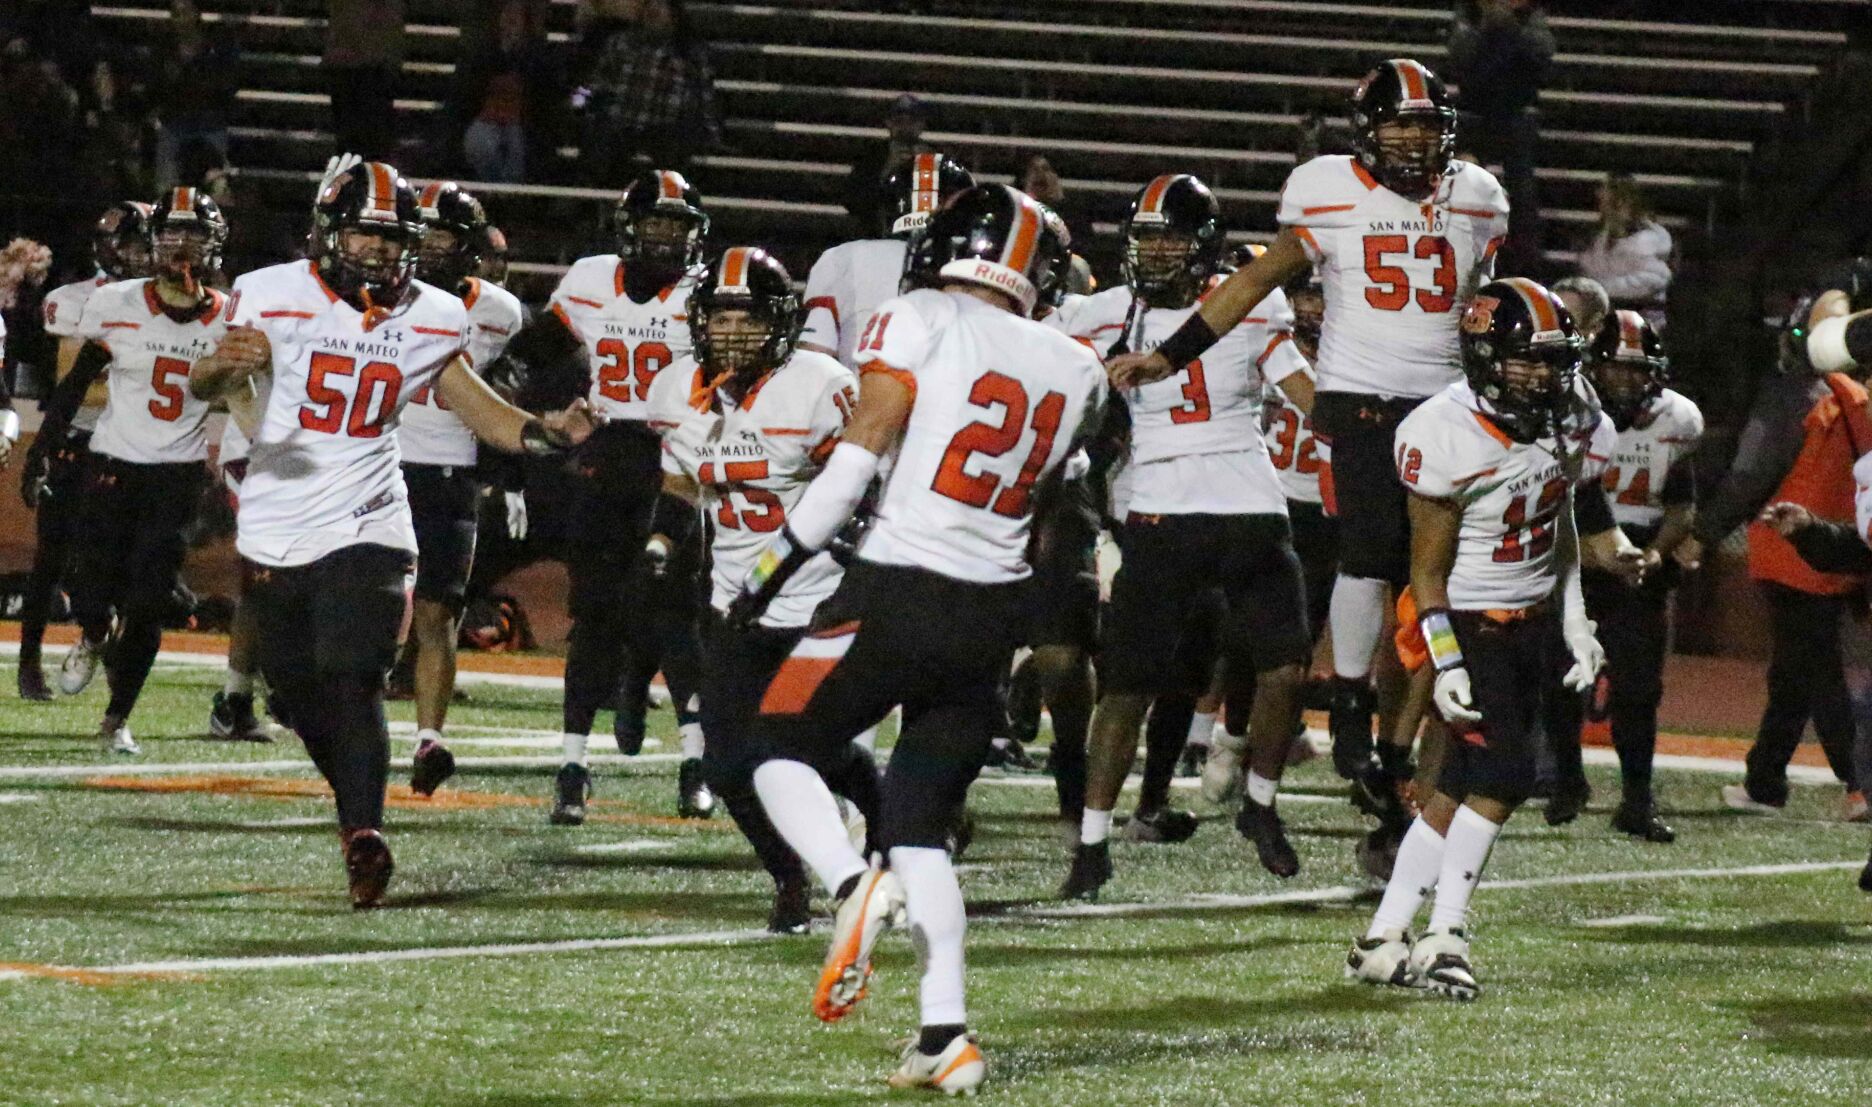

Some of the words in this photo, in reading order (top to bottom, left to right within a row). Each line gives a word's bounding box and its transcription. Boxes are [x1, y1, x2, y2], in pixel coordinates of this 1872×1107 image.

[1369, 221, 1394, 231] SAN
[1402, 220, 1443, 232] MATO
[1362, 235, 1457, 313] 53
[146, 341, 165, 351] SAN
[322, 337, 348, 349] SAN
[355, 342, 399, 358] MATEO
[604, 323, 623, 335] SAN
[628, 327, 666, 339] MATEO
[858, 312, 894, 350] 21
[148, 356, 190, 422] 5
[298, 351, 403, 438] 50
[695, 446, 715, 457] SAN
[721, 444, 763, 456] MATEO
[930, 370, 1066, 519] 21
[1397, 441, 1422, 484] 12
[698, 459, 785, 533] 15
[1507, 478, 1529, 494] SAN
